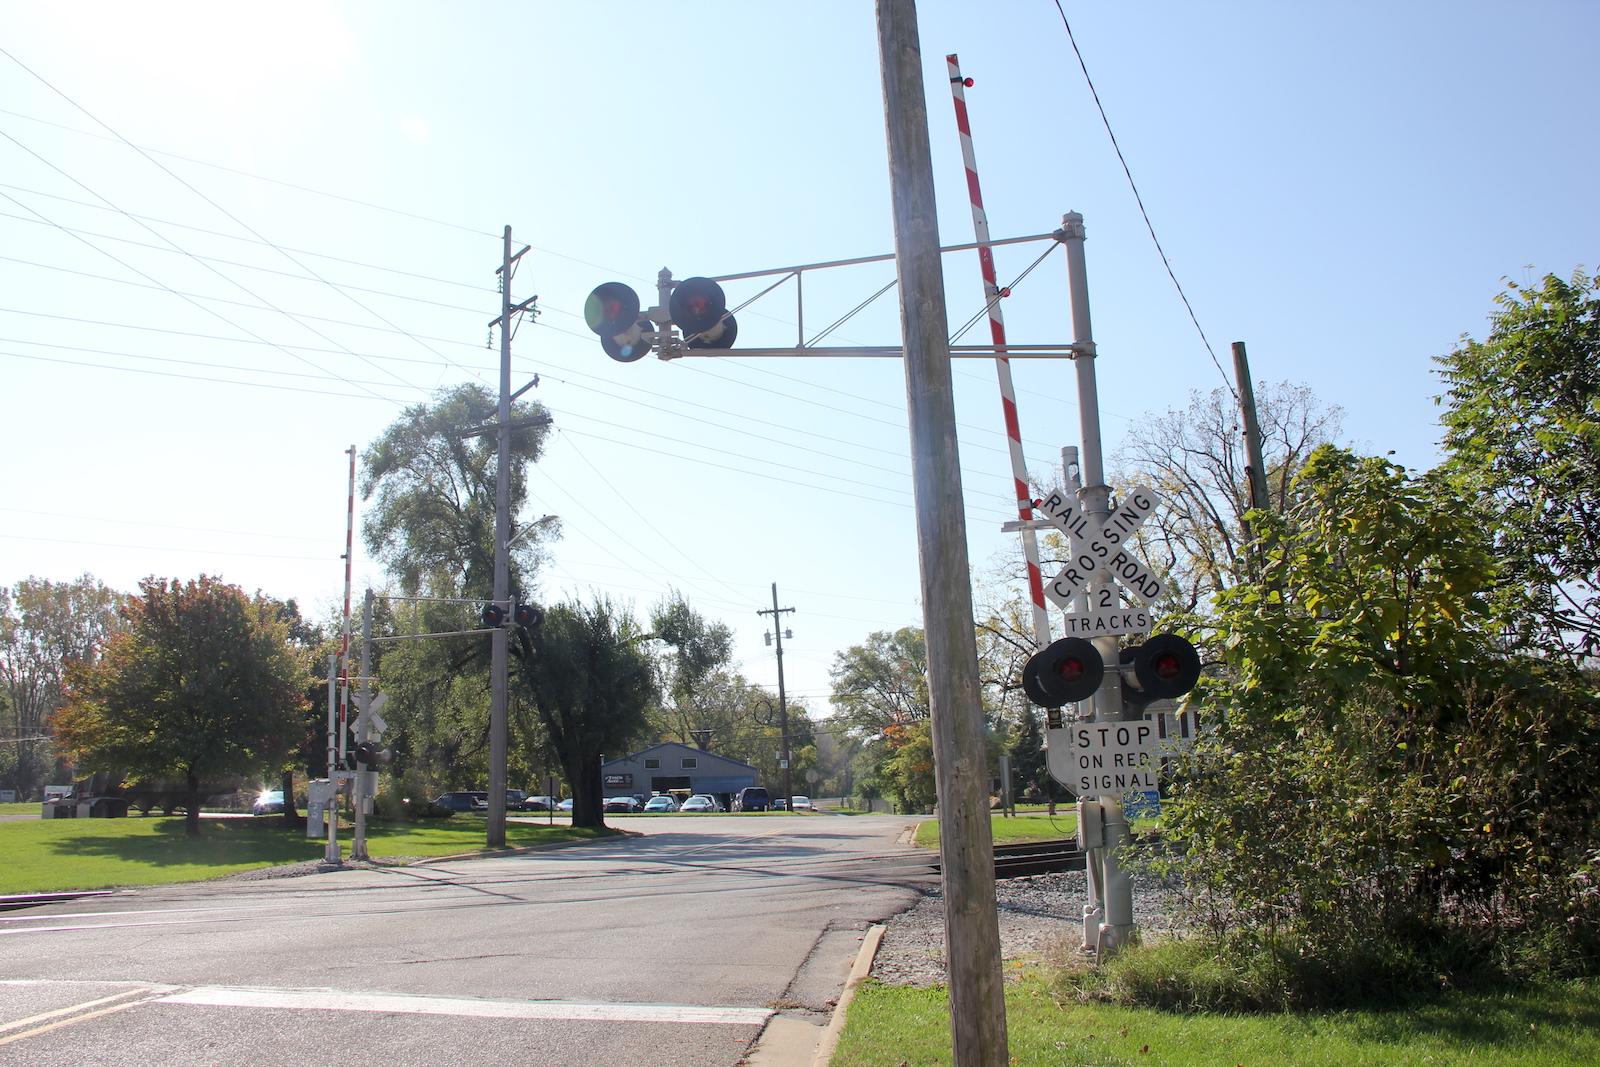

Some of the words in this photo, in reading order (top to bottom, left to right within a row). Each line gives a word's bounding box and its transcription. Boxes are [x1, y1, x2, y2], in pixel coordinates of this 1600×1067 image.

[1043, 493, 1088, 540] RAIL
[1054, 494, 1151, 598] CROSSING
[1109, 551, 1160, 599] ROAD
[1098, 589, 1112, 608] 2
[1068, 613, 1147, 632] TRACKS
[1078, 726, 1150, 748] STOP
[1079, 754, 1103, 769] ON
[1114, 752, 1149, 768] RED
[1081, 773, 1154, 790] SIGNAL
